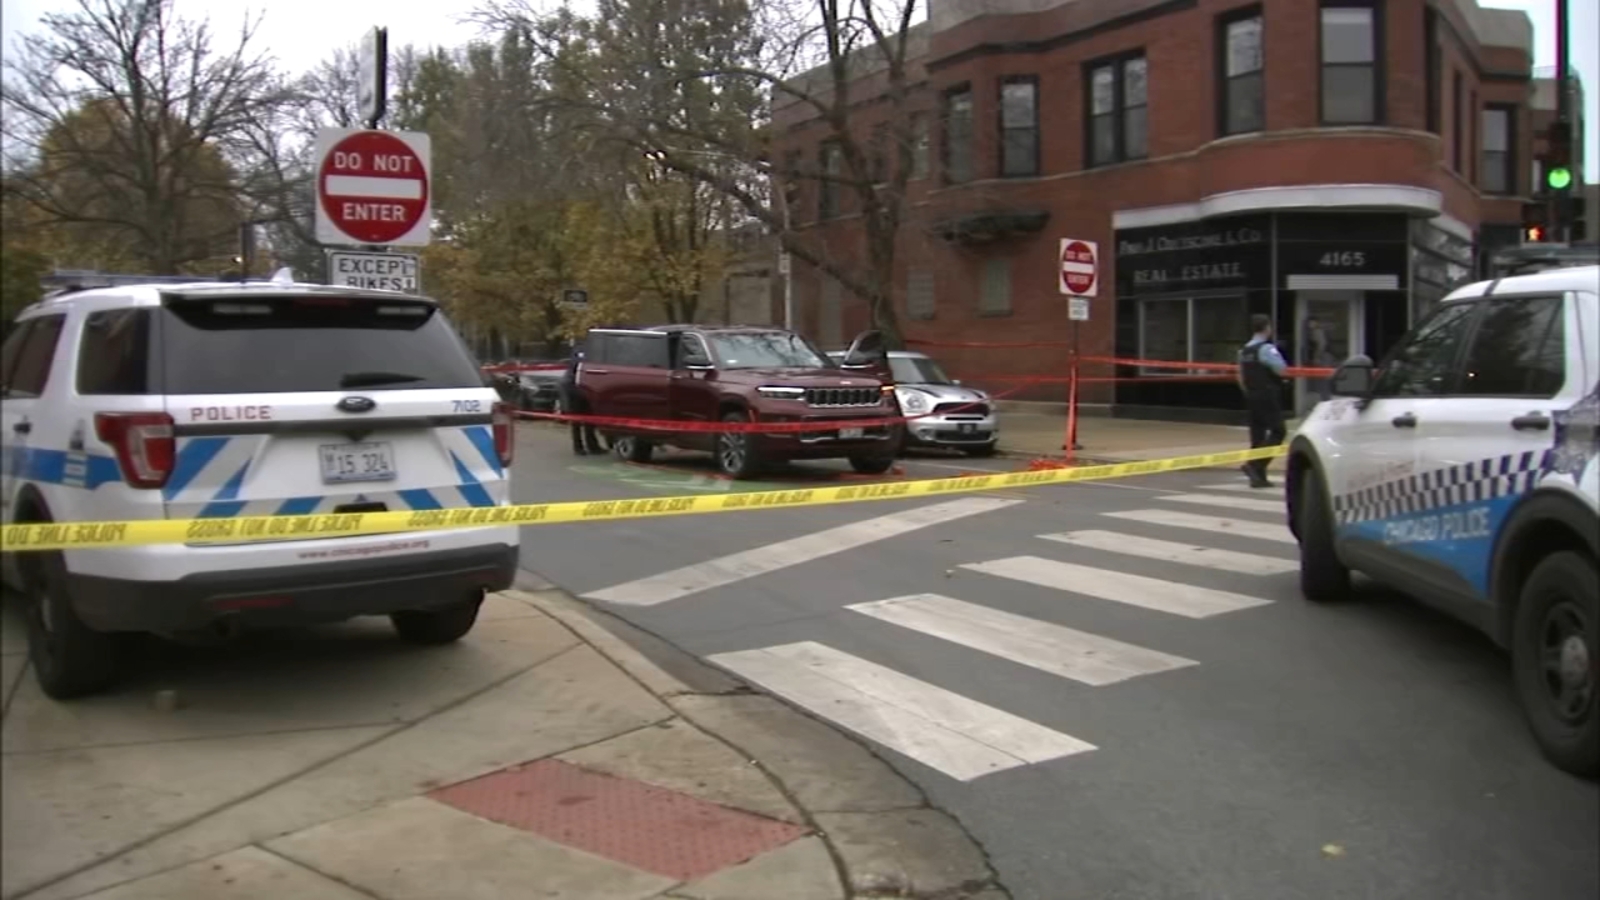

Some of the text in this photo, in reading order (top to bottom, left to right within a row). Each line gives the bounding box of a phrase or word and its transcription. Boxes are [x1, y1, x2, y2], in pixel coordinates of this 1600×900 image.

[334, 152, 414, 172] DO NOT
[342, 202, 406, 222] ENTER
[339, 258, 406, 275] EXCEPT
[1319, 251, 1366, 266] 4165
[1134, 262, 1243, 283] REAL ESTATE
[346, 276, 402, 290] BIKES
[190, 405, 271, 421] POLICE
[451, 400, 481, 412] 7102
[1384, 507, 1490, 544] CHICAGO POLICE
